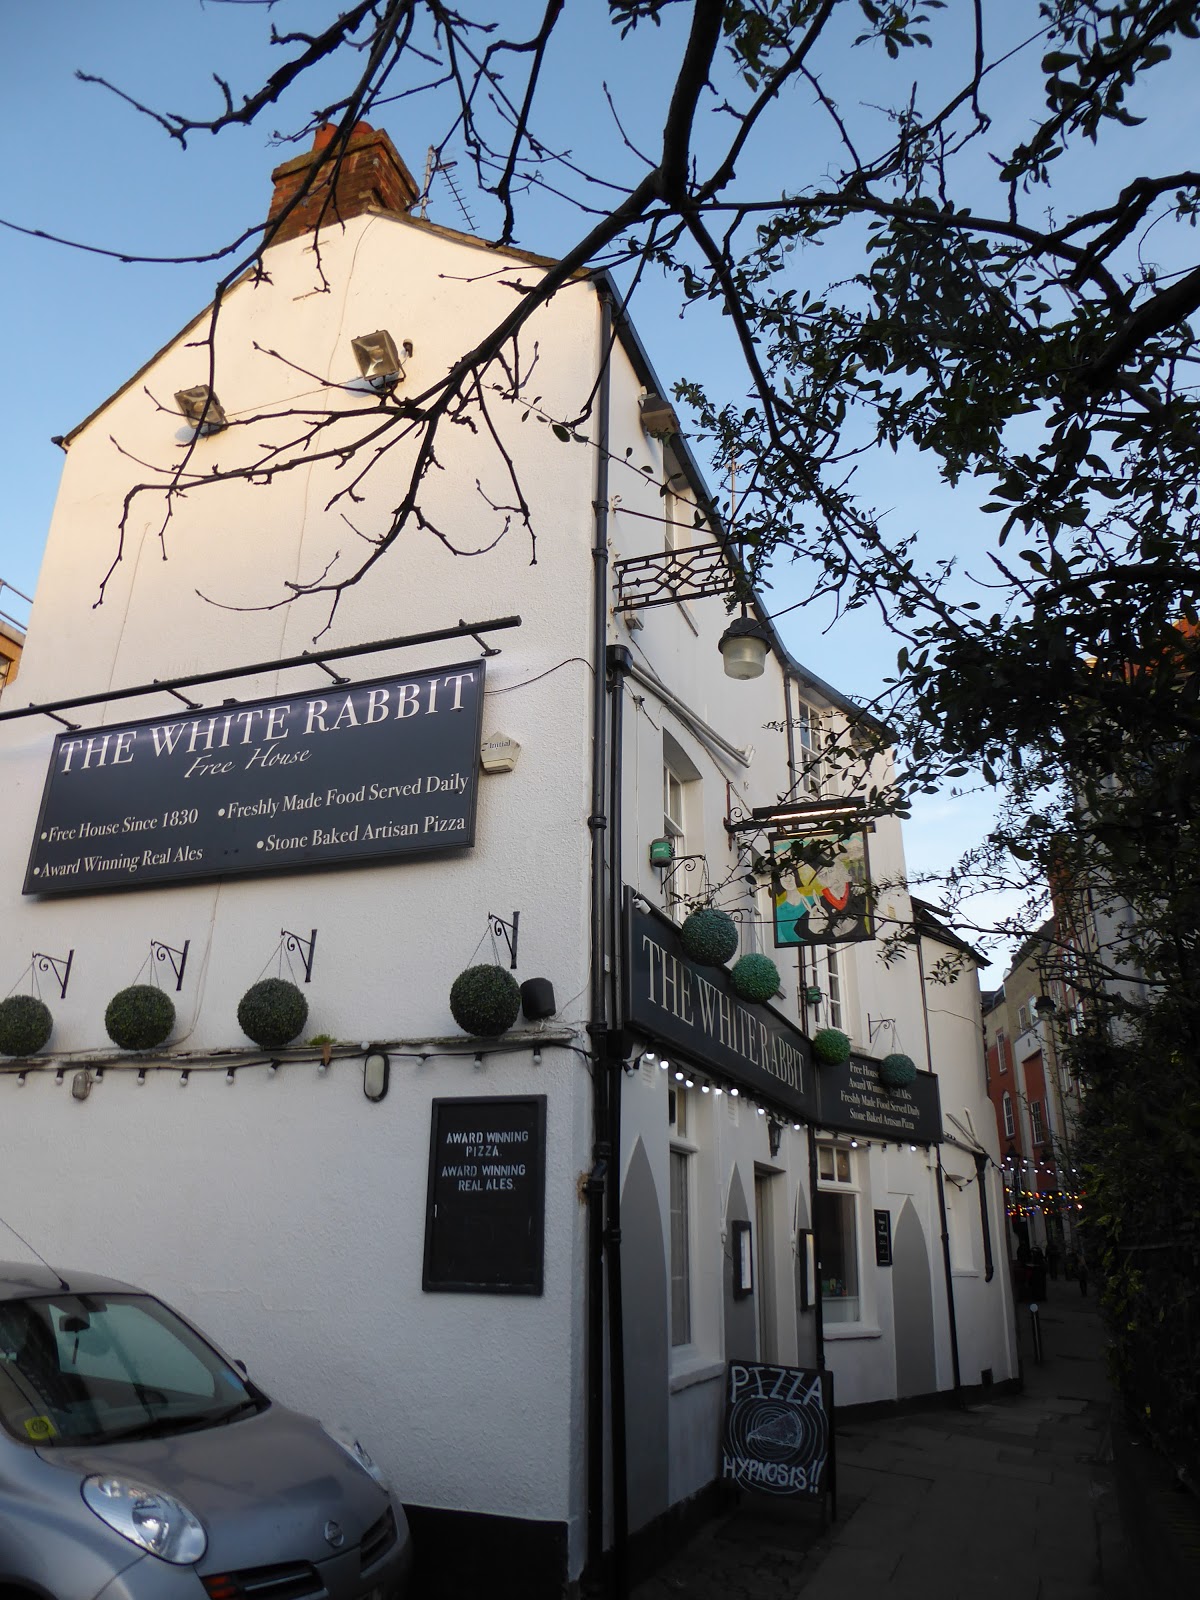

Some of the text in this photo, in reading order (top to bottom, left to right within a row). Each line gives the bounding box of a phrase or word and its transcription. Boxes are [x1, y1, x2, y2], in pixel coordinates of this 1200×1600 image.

[59, 672, 475, 774] THE WHITE RABBIT
[183, 742, 313, 779] Free House
[489, 739, 511, 749] Initial
[227, 772, 470, 819] Freshly Made Food Served Daily
[48, 807, 199, 843] Free House Since 1830
[265, 815, 466, 852] Stone Baked Artisan Pizza
[40, 845, 203, 878] Award Winning Real Ales
[642, 933, 805, 1095] THE WHITE RABBIT
[446, 1130, 529, 1144] AWARD WINNING
[441, 1163, 526, 1178] AWARD WINNING
[458, 1178, 484, 1192] REAL
[731, 1365, 824, 1411] PIZZA
